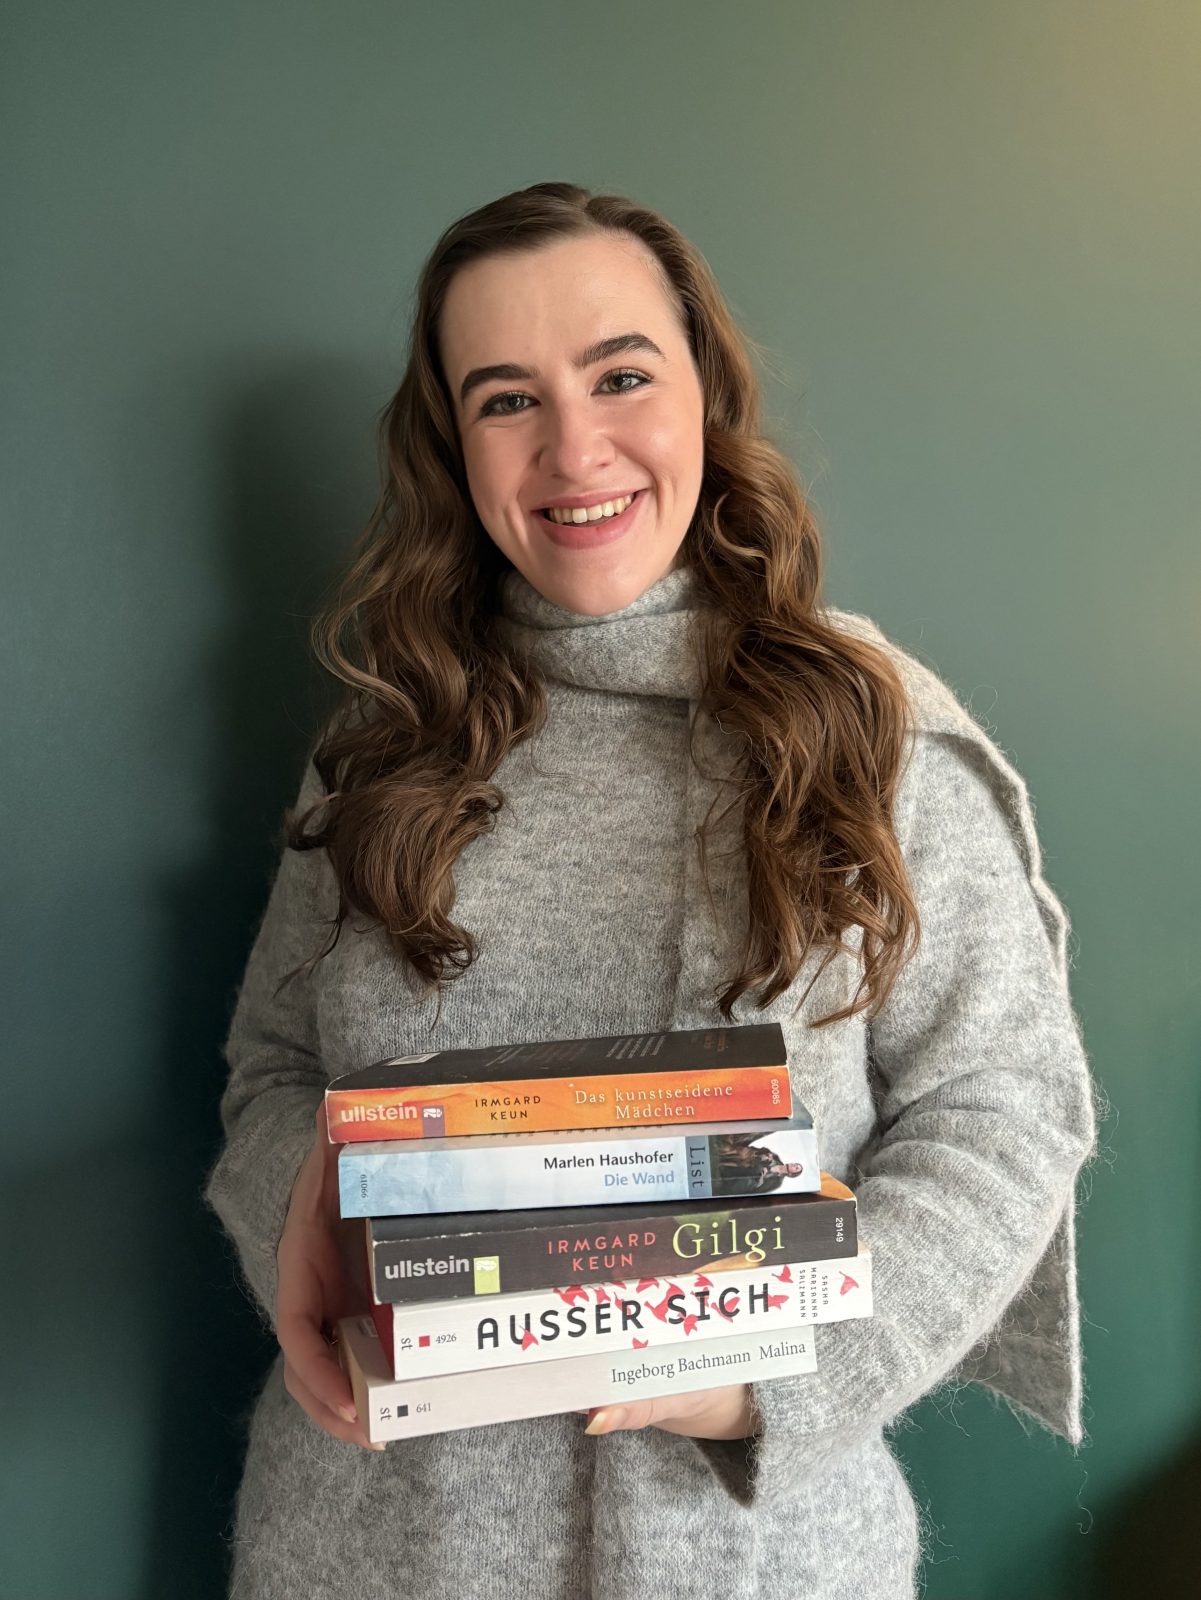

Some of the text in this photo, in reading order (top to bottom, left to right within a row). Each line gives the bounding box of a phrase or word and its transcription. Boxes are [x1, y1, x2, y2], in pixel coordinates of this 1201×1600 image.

[475, 1095, 542, 1108] IRMGARD
[575, 1084, 733, 1105] Das kunstseidene
[770, 1078, 781, 1105] 60085
[340, 1104, 418, 1123] ullstein
[490, 1110, 529, 1121] KEUN
[615, 1104, 695, 1120] Mädchen
[543, 1150, 674, 1170] Marlen Haushofer
[689, 1146, 706, 1188] List
[360, 1174, 368, 1199] 61066
[604, 1171, 675, 1187] Die Wand
[672, 1216, 785, 1263] Gilgi
[834, 1217, 844, 1243] 29149
[547, 1231, 656, 1254] IRMGARD
[384, 1255, 470, 1280] ullstein
[572, 1254, 634, 1272] KEUN
[810, 1267, 818, 1318] MARIANNA
[821, 1275, 829, 1305] SASHA
[477, 1282, 770, 1350] AUSSER SICH
[435, 1332, 457, 1344] 4926
[611, 1341, 806, 1385] Ingeborg Bachmann Malina
[416, 1402, 431, 1413] 641
